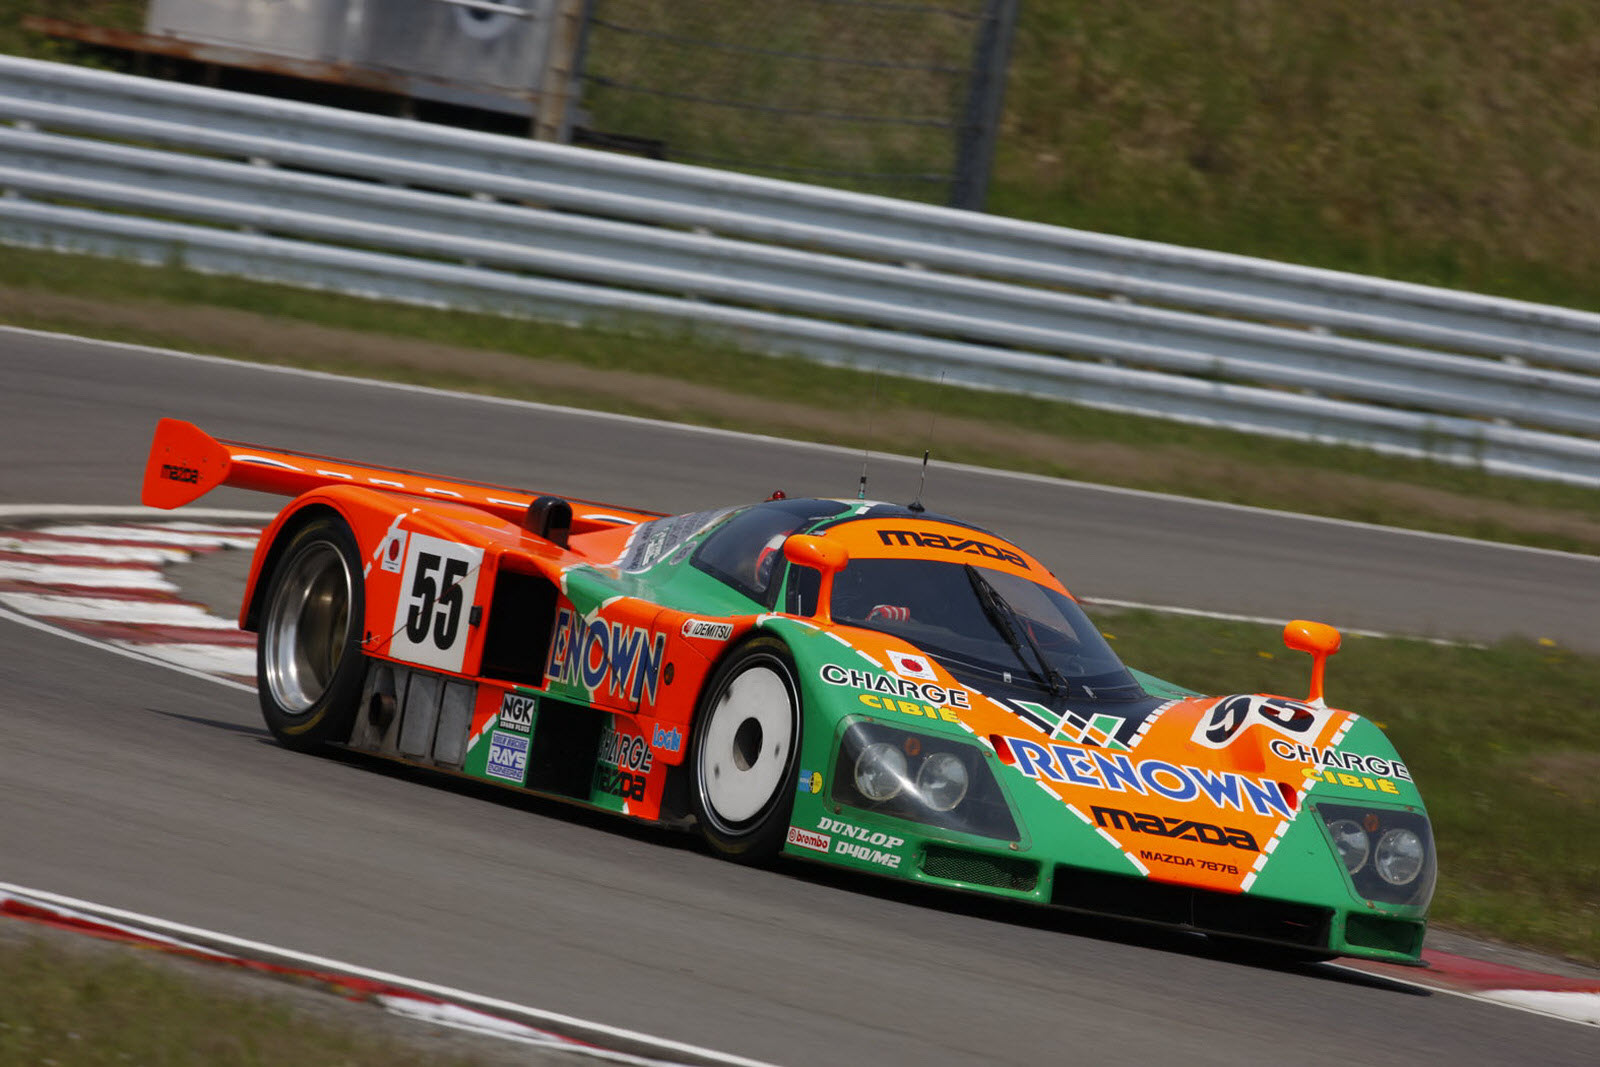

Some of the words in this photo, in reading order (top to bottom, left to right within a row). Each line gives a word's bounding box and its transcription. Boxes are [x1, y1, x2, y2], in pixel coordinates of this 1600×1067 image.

[406, 551, 469, 651] 55
[692, 622, 732, 639] IDEMITSU
[546, 607, 667, 706] ENOWN
[821, 664, 970, 710] CHARGE
[502, 696, 533, 722] NGK
[489, 746, 527, 769] RAYS
[1270, 739, 1410, 783] CHARGE
[1007, 736, 1296, 820] RENOWN
[817, 816, 904, 850] DUNLOP
[1139, 849, 1195, 868] MAZDA
[1197, 858, 1239, 875] 787B
